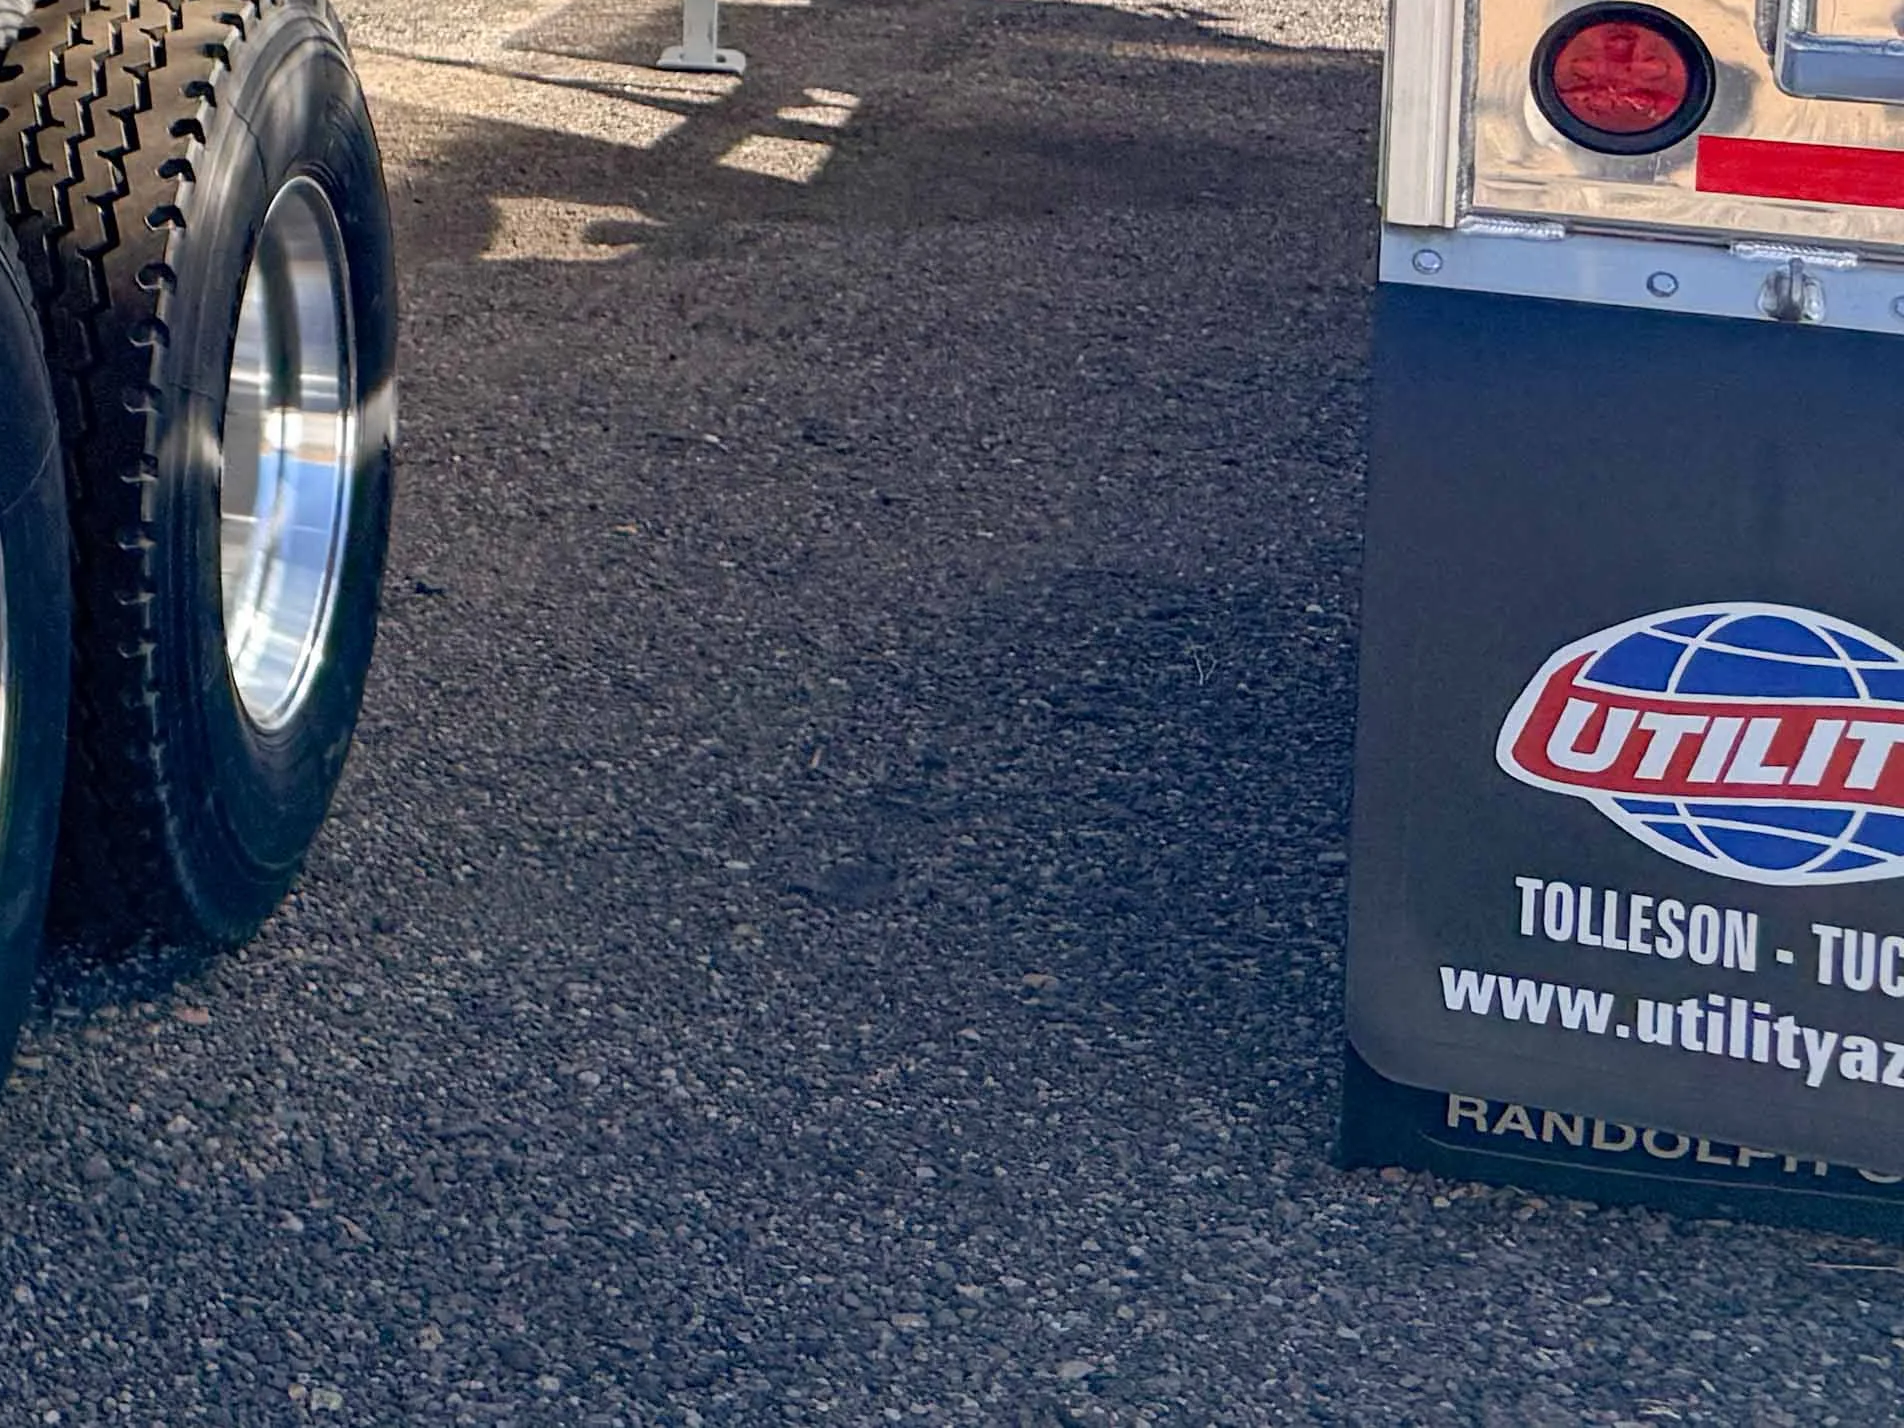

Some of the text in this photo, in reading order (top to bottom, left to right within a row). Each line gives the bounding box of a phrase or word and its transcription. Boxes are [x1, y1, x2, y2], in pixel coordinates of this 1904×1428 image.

[1546, 696, 1904, 791] UTILIT
[1514, 876, 1759, 973] TOLLESON
[1811, 923, 1904, 999] TUC
[1439, 966, 1904, 1088] www.utilityaz
